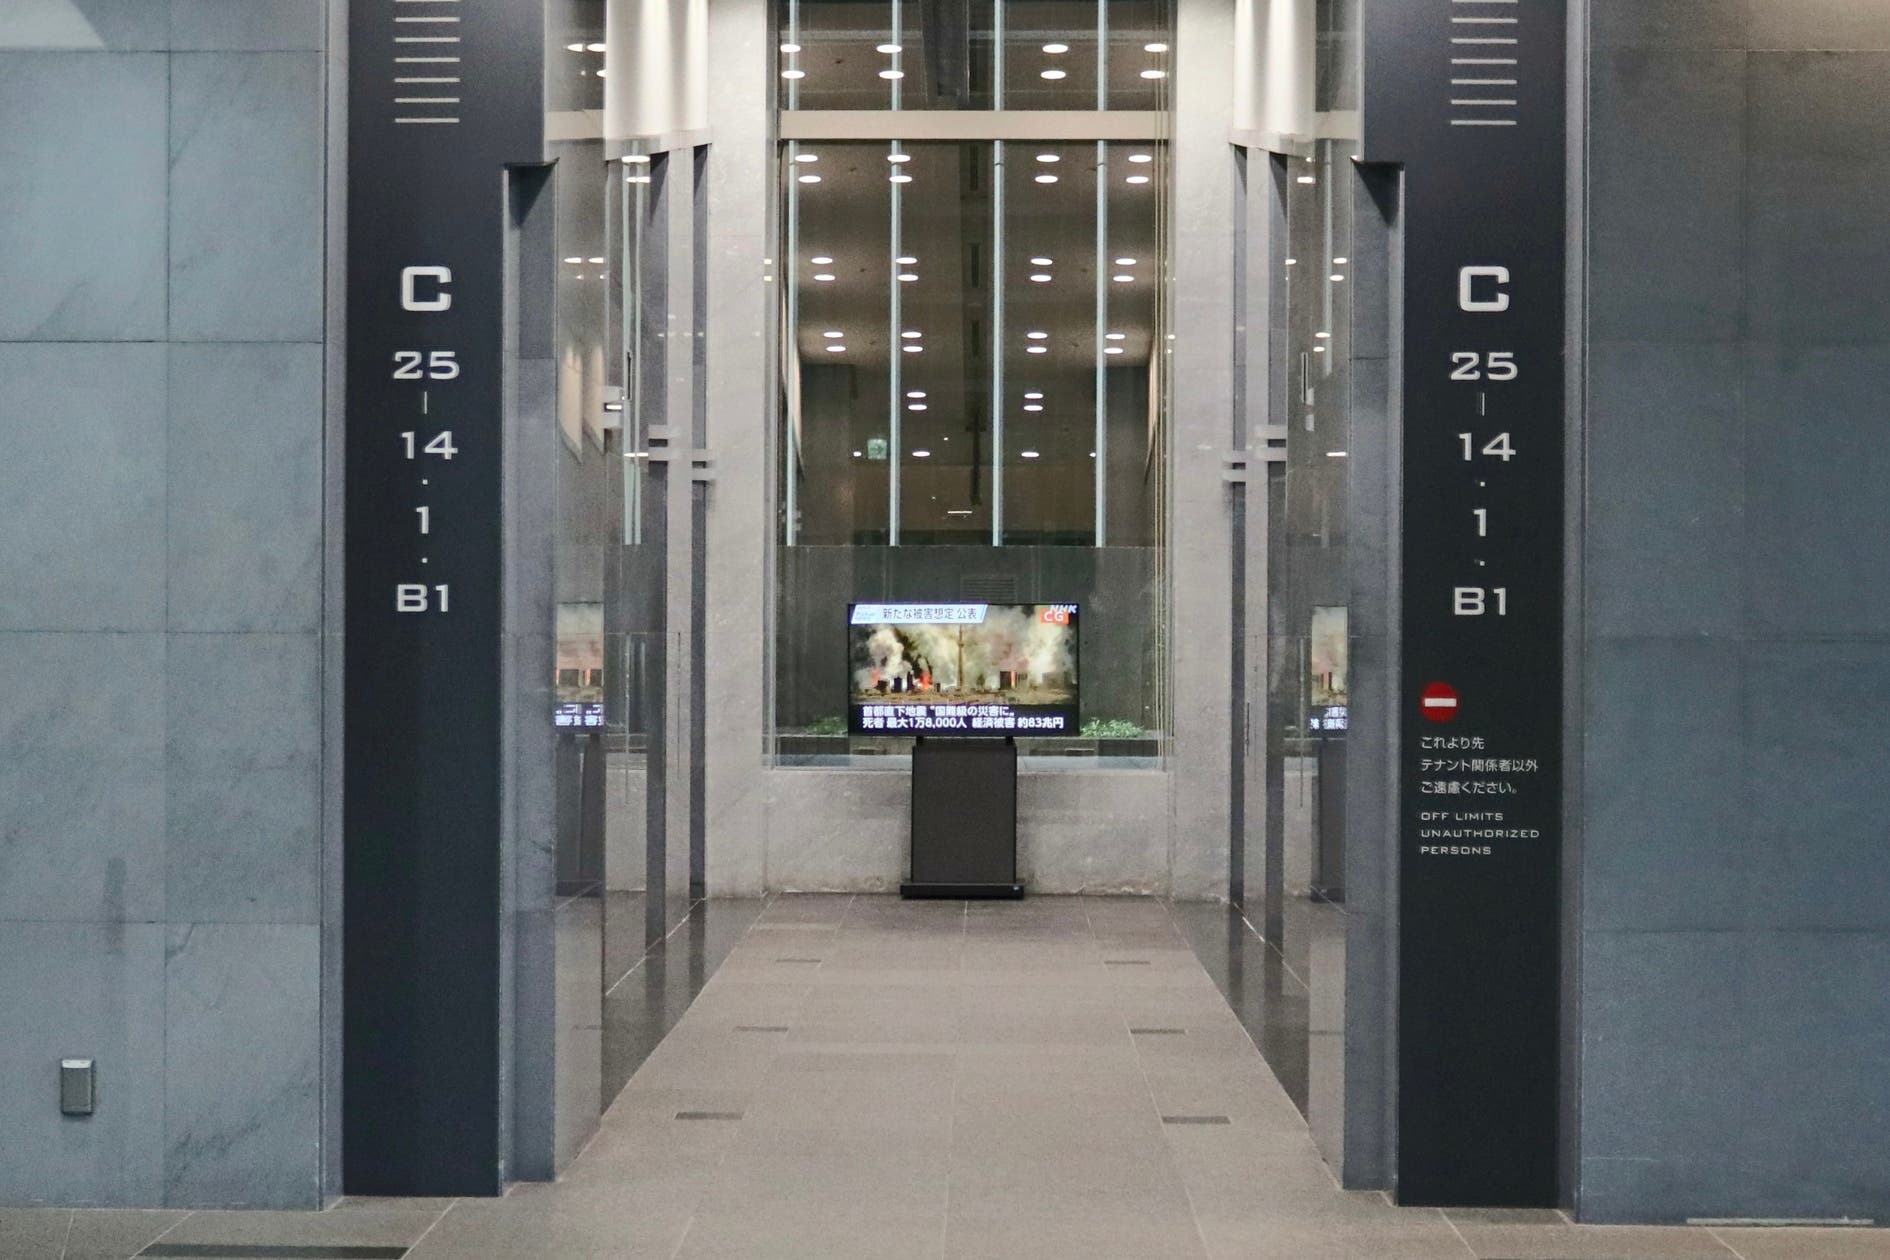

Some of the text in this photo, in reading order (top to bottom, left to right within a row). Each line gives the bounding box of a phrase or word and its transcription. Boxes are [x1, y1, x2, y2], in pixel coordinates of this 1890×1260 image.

[401, 265, 452, 312] C
[1459, 265, 1510, 312] C
[392, 350, 460, 380] 25
[1450, 351, 1518, 381] 25
[401, 430, 459, 460] 14
[1458, 432, 1517, 462] 14
[415, 505, 430, 535] 1
[1473, 508, 1487, 537] 1
[396, 583, 449, 613] B1
[1050, 604, 1077, 613] NHK
[1454, 587, 1506, 616] B1
[1044, 611, 1064, 622] CG
[862, 717, 885, 729] 死者
[971, 717, 1016, 729] 経済被害
[1421, 736, 1485, 750] これより先
[1421, 758, 1539, 773] テナント関係者以外
[1421, 780, 1518, 795] ご遠慮ください。
[1420, 811, 1504, 821] OFF LIMITS
[1420, 828, 1540, 839] UNAUTHORIZED
[1420, 845, 1492, 855] PERSONS
